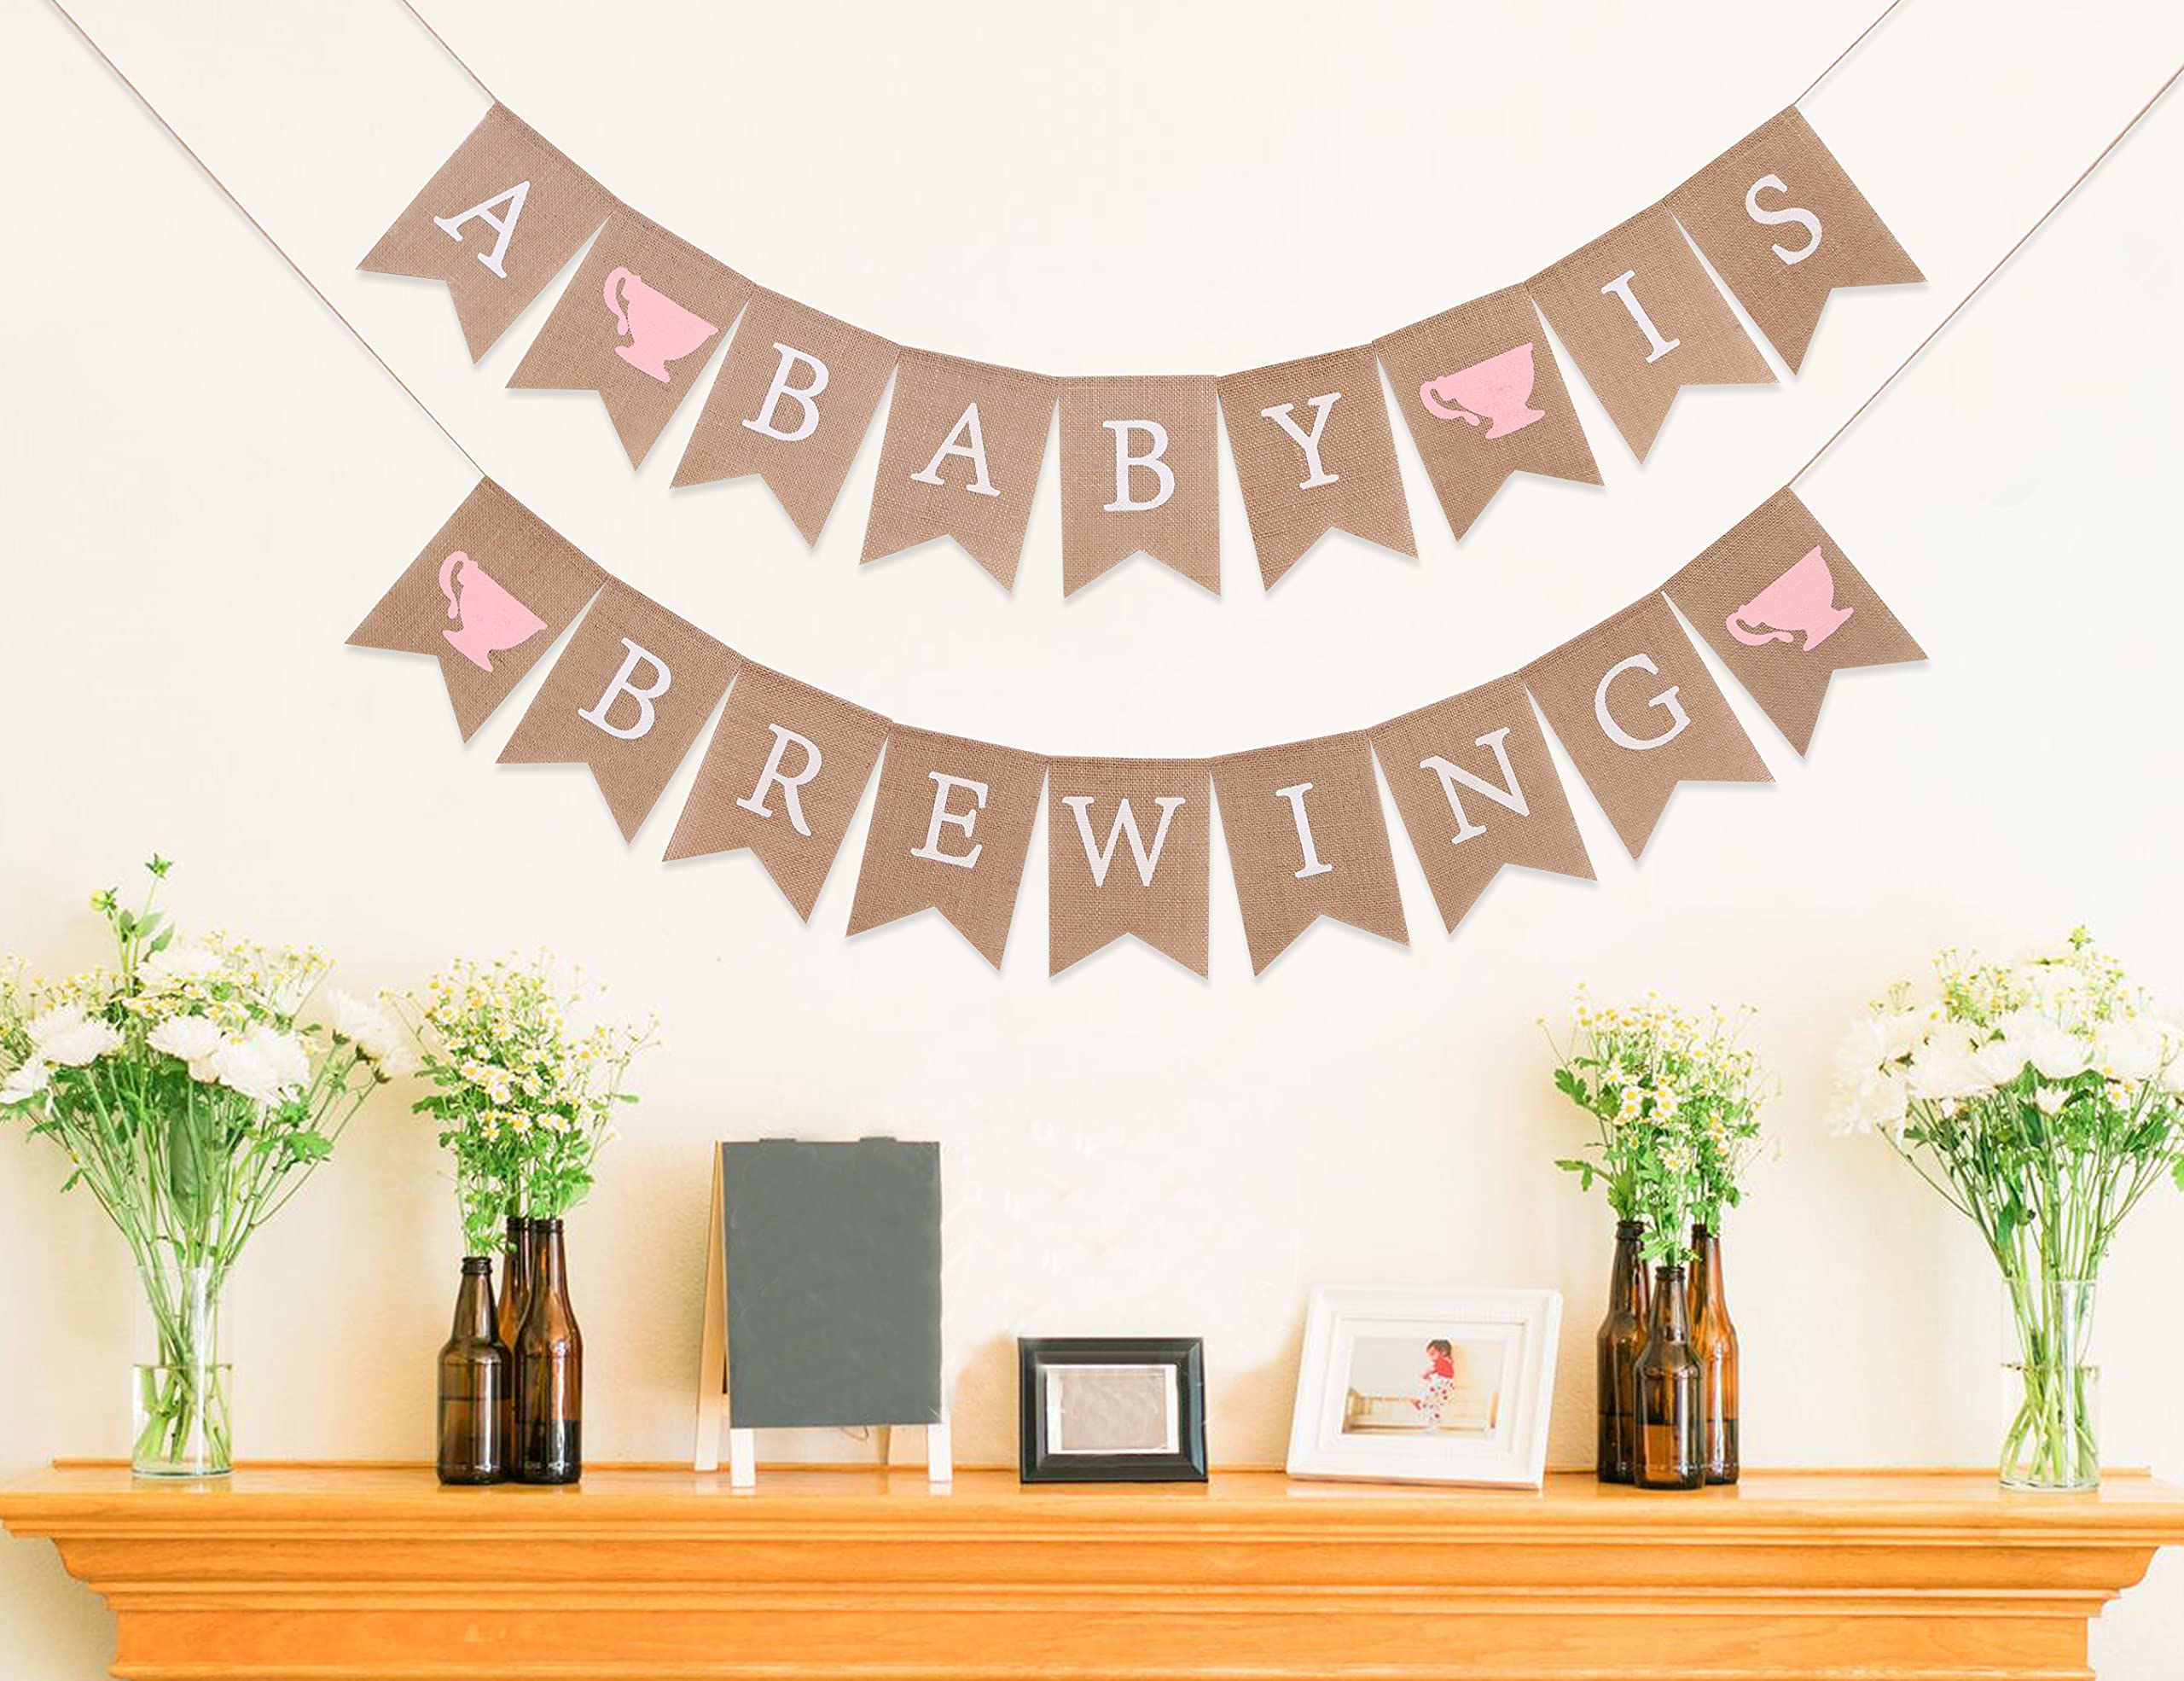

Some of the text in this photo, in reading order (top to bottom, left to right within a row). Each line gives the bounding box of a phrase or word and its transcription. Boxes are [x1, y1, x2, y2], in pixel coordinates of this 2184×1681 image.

[433, 174, 1823, 513] A BABY IS
[578, 637, 1691, 888] BREWING
